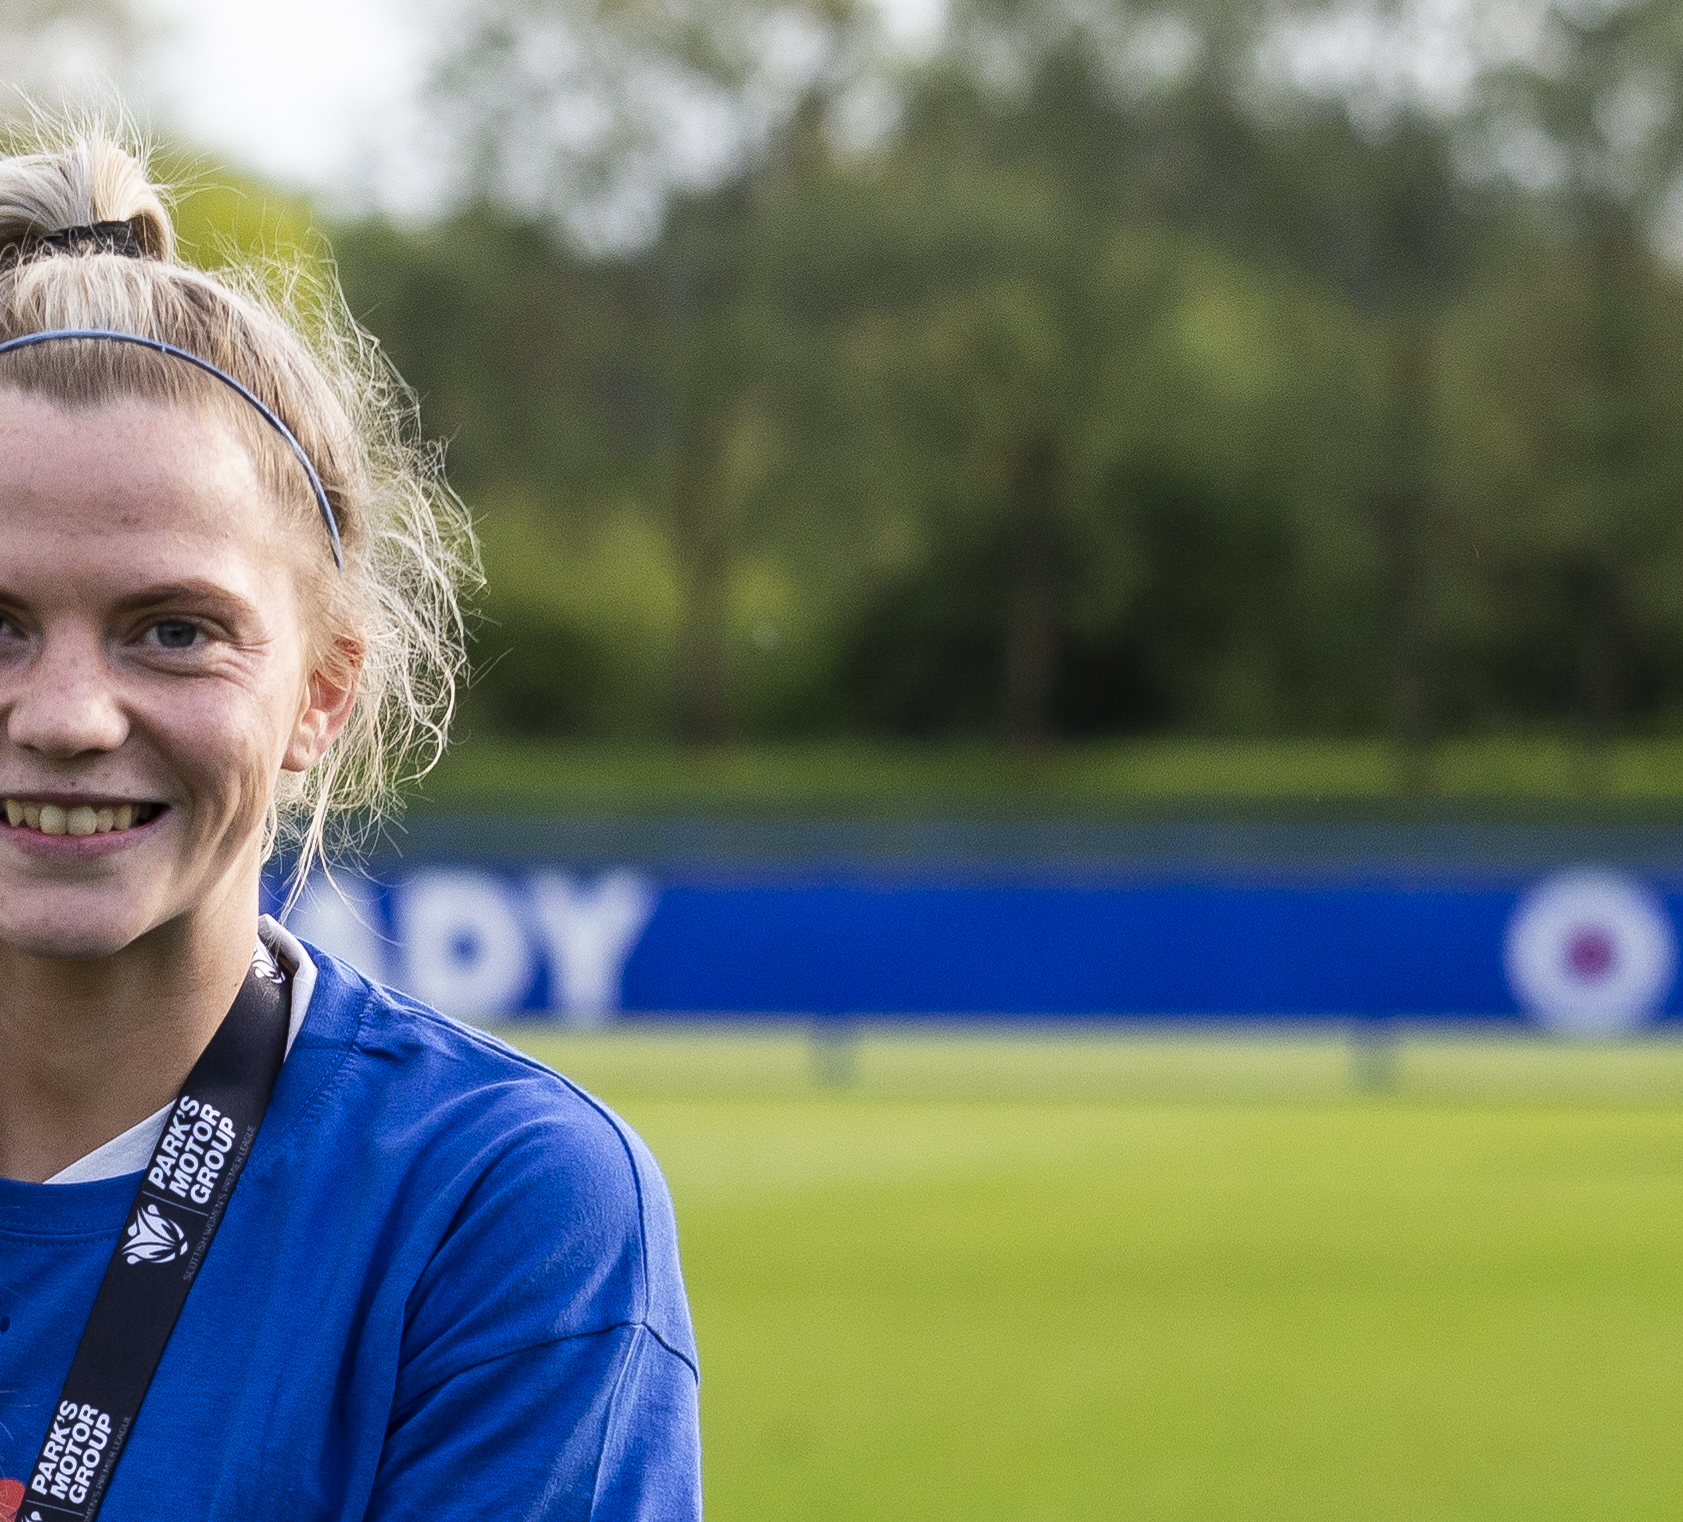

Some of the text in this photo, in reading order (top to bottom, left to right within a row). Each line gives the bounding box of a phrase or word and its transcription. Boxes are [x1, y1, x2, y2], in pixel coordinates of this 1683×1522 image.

[148, 1096, 200, 1190] PARK'S
[169, 1104, 220, 1198] MOTOR
[190, 1117, 236, 1204] GROUP
[31, 1400, 78, 1495] PARK'S
[50, 1404, 98, 1500] MOTOR
[69, 1413, 112, 1504] GROUP
